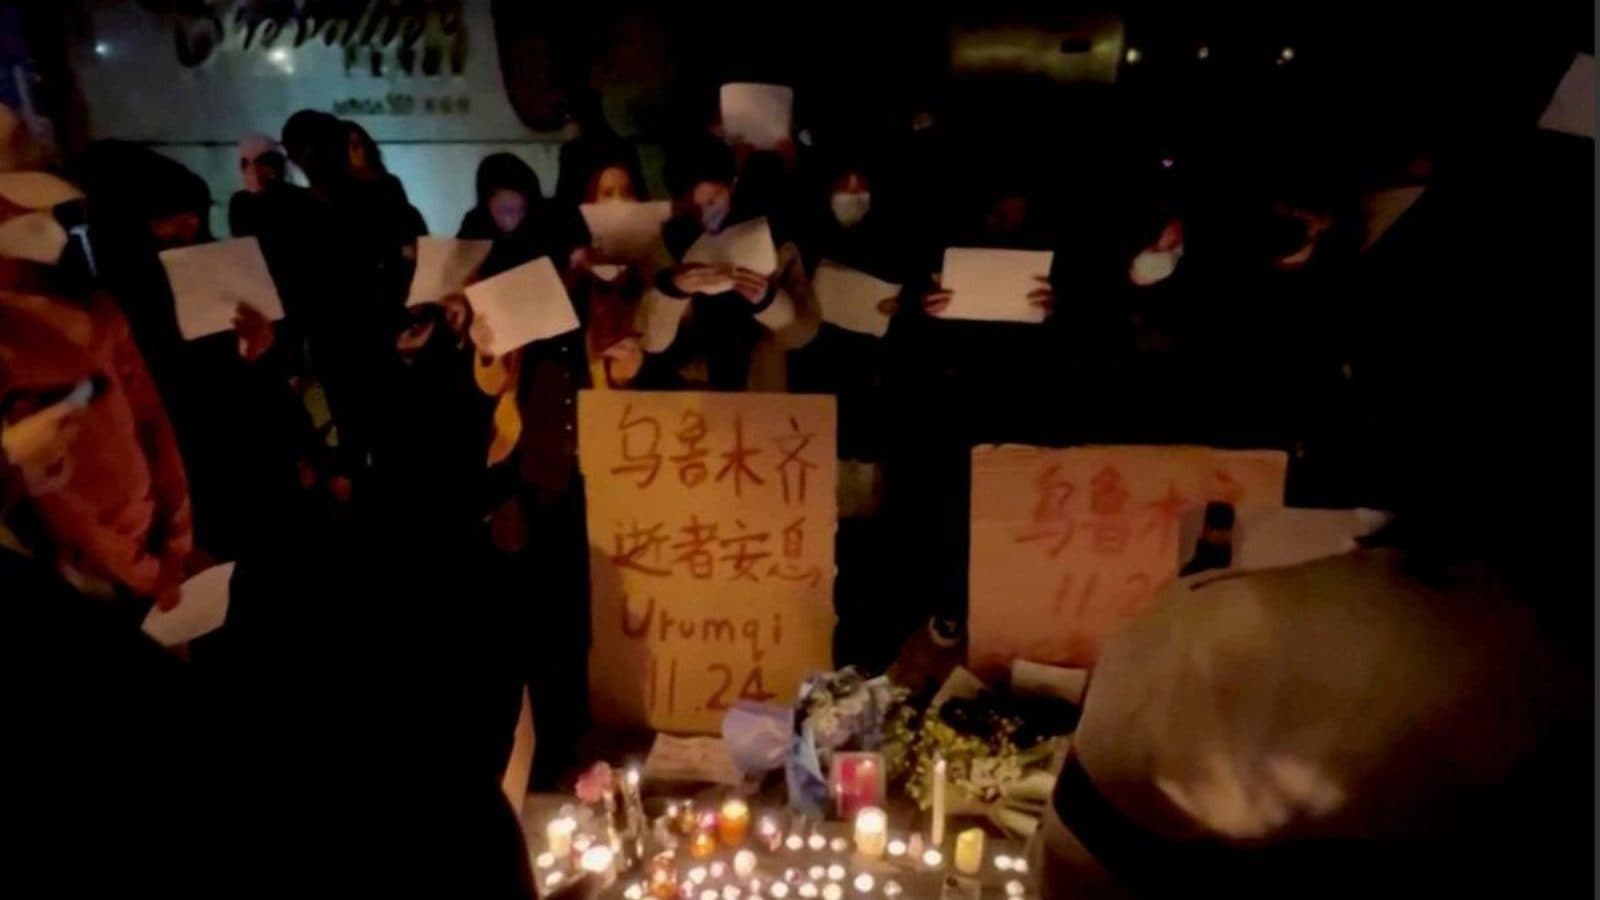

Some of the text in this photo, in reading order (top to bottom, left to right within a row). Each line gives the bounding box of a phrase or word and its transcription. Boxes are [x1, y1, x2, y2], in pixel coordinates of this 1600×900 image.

[611, 403, 818, 504] 乌鲁木齐
[1014, 463, 1244, 560] 乌鲁木
[621, 594, 783, 660] Urumqi
[649, 657, 777, 717] 11.24
